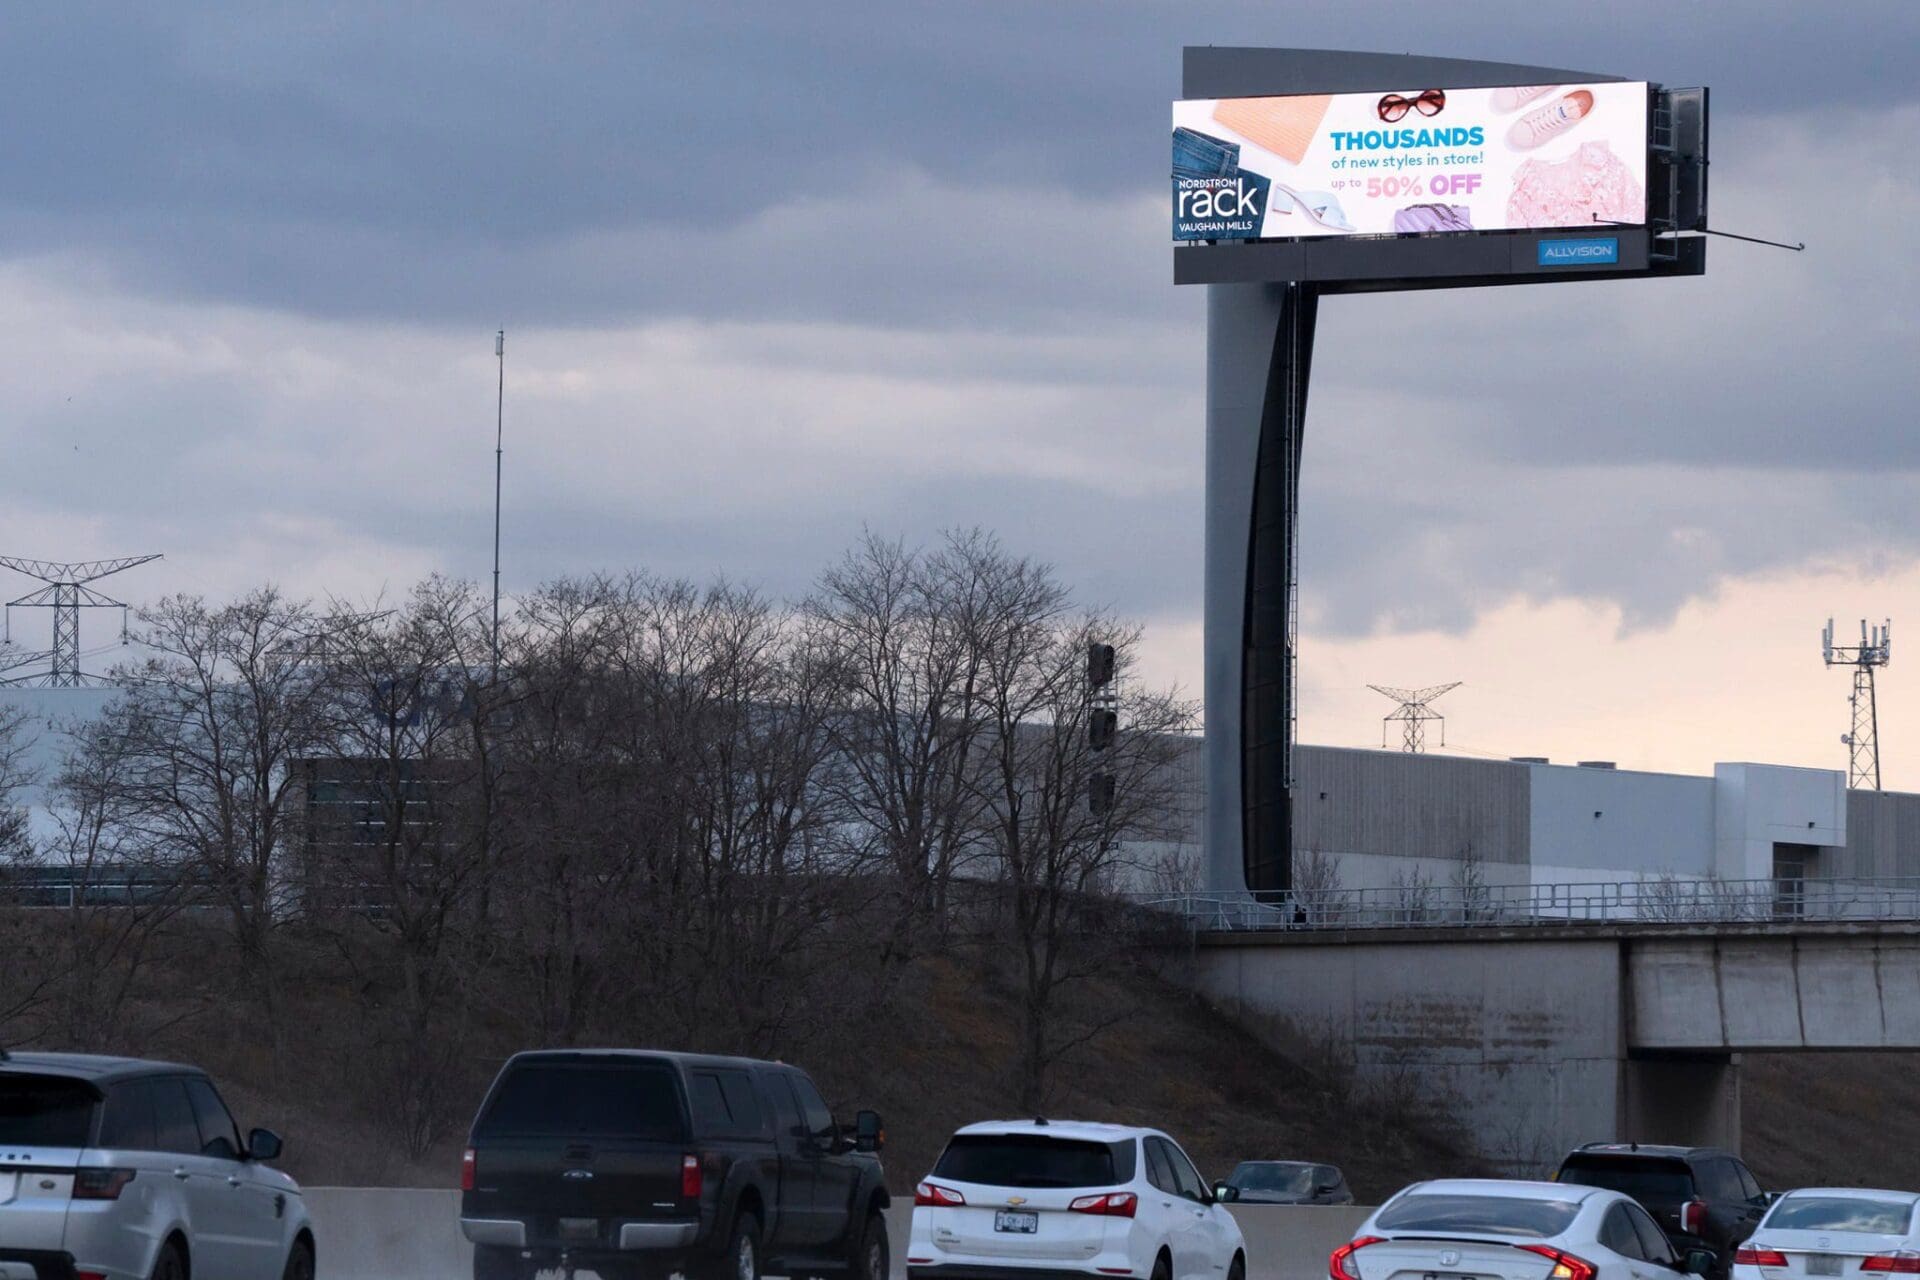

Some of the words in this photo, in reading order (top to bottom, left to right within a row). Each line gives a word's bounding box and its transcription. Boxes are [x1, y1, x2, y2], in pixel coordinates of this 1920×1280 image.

[1330, 126, 1484, 151] THOUSANDS
[1331, 156, 1347, 169] of
[1350, 158, 1379, 168] new
[1382, 154, 1423, 170] styles
[1427, 153, 1439, 166] in
[1443, 151, 1484, 165] store!
[1179, 178, 1237, 189] NORDSTROM
[1331, 180, 1346, 190] up
[1349, 178, 1362, 188] to
[1366, 175, 1423, 198] 50%
[1429, 173, 1482, 196] OFF
[1179, 178, 1259, 218] rack
[1179, 222, 1225, 232] VAUGHAN
[1226, 220, 1253, 230] MILLS
[1545, 246, 1612, 257] ALLVISION
